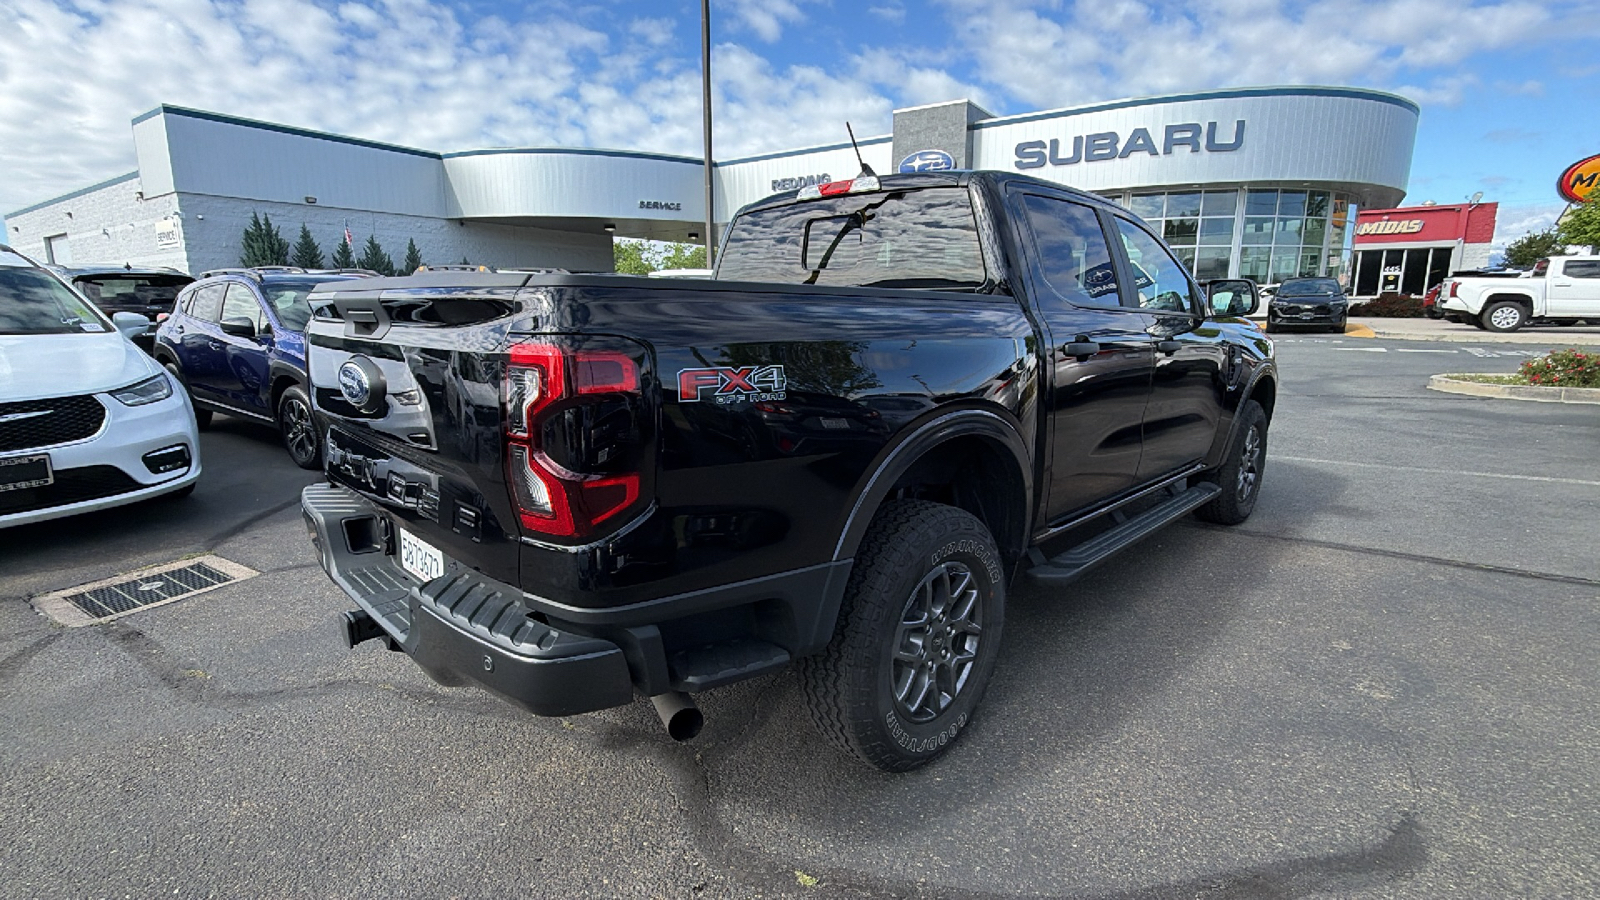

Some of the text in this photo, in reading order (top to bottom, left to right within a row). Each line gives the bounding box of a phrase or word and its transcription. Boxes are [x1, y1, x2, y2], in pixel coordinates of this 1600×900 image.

[1014, 119, 1246, 169] SUBARU
[771, 173, 832, 192] REDDING
[639, 200, 682, 211] SERVICE
[157, 230, 176, 242] SERVICE
[1356, 215, 1424, 235] MIDAS
[677, 364, 788, 403] FX4
[716, 392, 787, 404] OFF ROAD
[328, 437, 482, 544] RANGER
[931, 539, 1000, 584] WRANGLER
[885, 710, 967, 753] GOODYEAR
